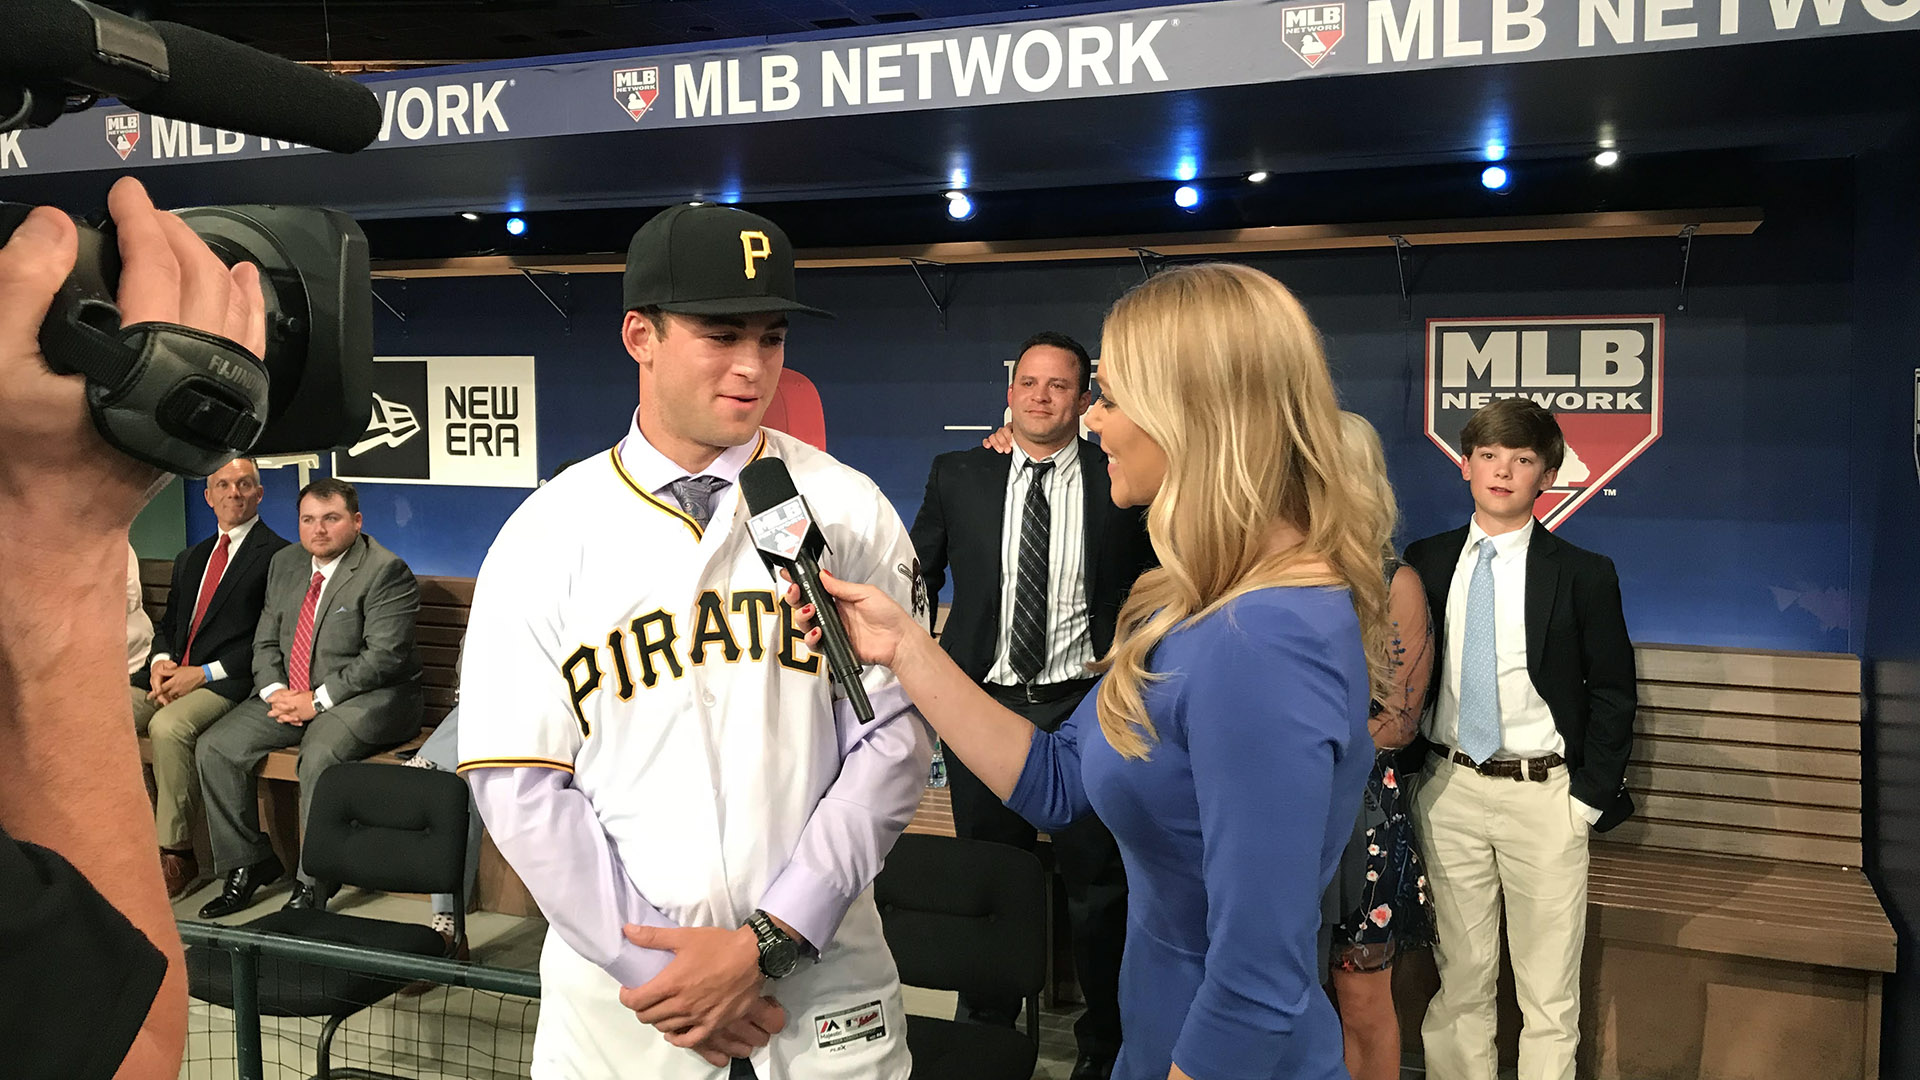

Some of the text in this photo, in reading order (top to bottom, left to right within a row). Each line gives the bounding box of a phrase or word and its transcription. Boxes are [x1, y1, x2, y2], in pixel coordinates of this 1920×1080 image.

[1286, 7, 1341, 28] MLB
[1286, 23, 1340, 34] NETWORK
[1367, 0, 1547, 64] MLB
[616, 70, 656, 87] MLB
[674, 19, 1169, 119] MLB NETWORK
[616, 84, 656, 93] NETWORK
[108, 116, 137, 131] MLB
[740, 230, 772, 279] P
[1441, 329, 1645, 388] MLB
[445, 386, 519, 420] NEW
[446, 423, 519, 457] ERA
[752, 500, 803, 536] MLB
[561, 588, 834, 740] PIRATE
